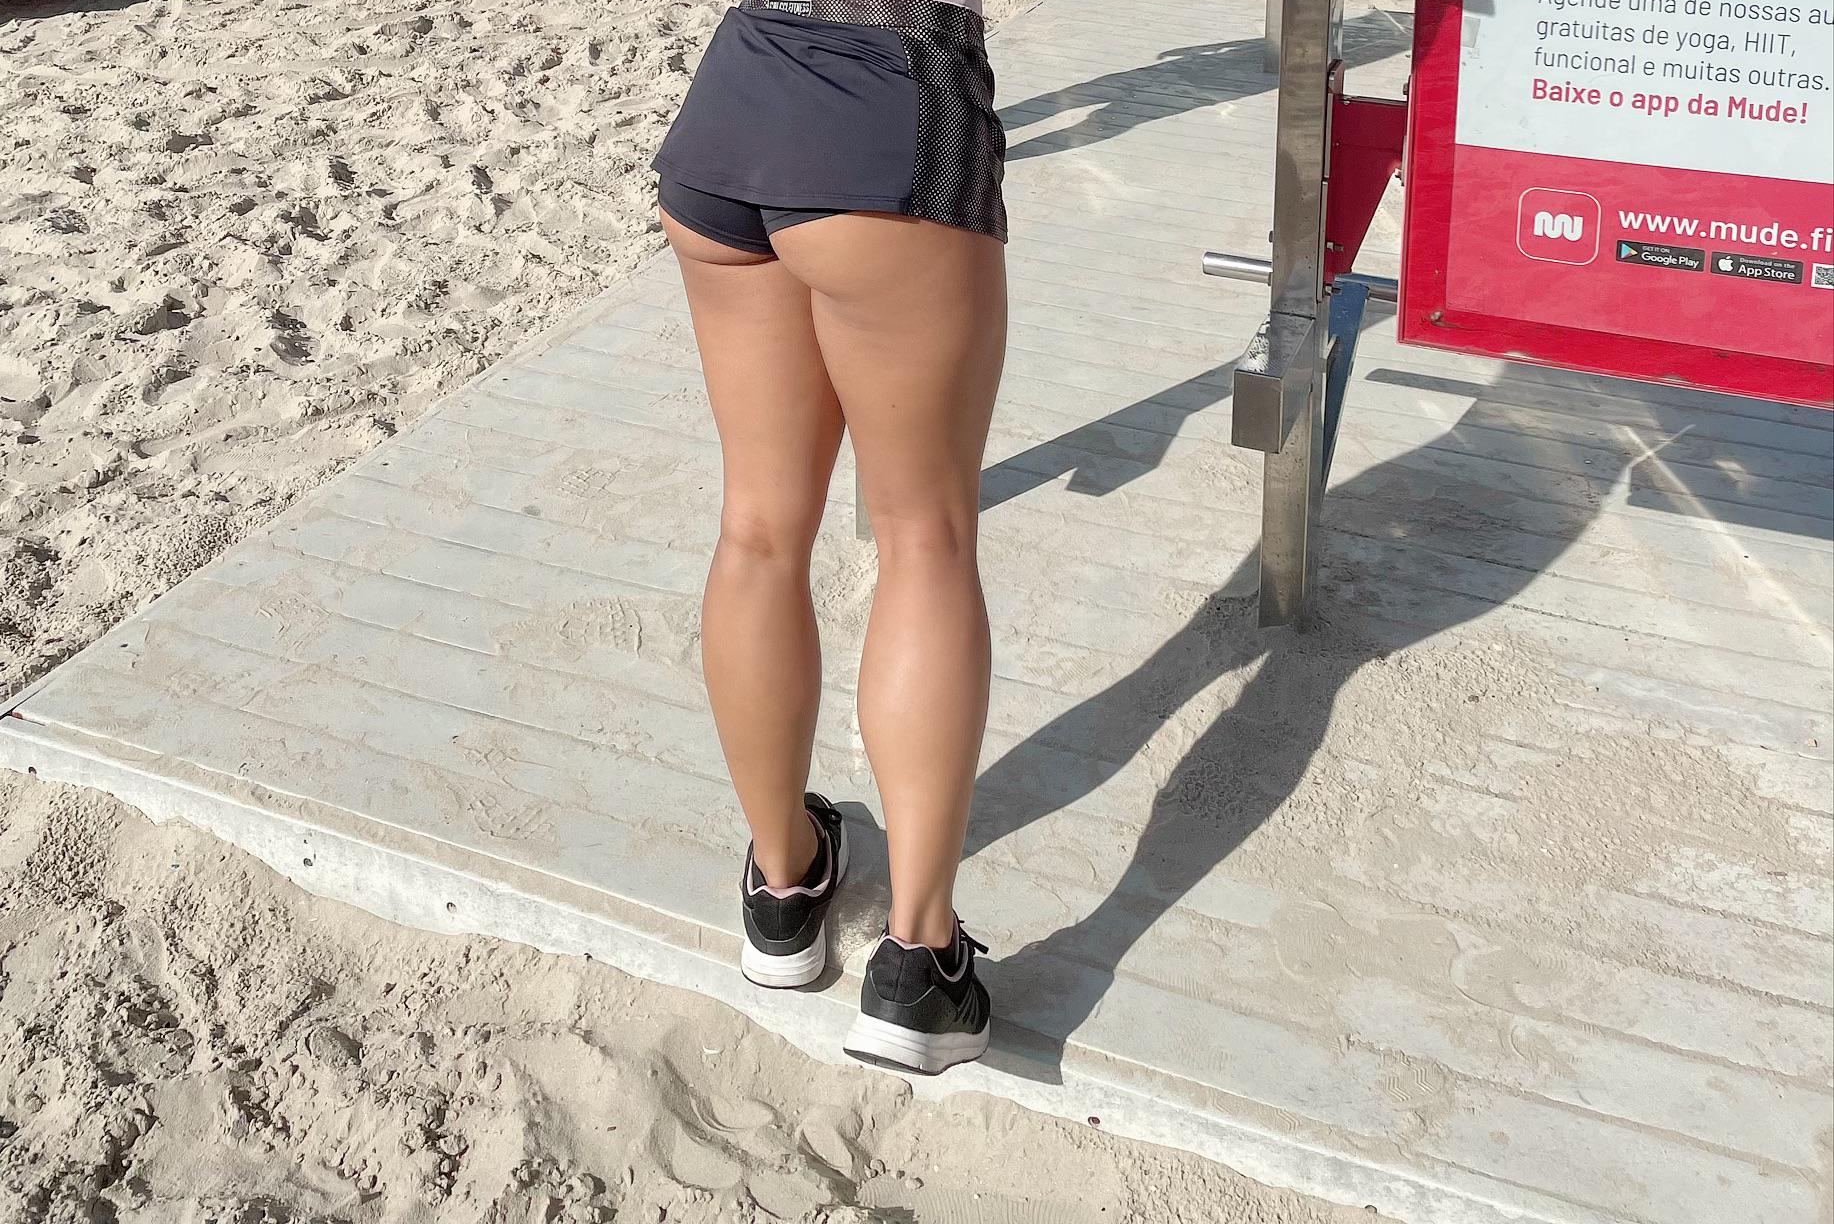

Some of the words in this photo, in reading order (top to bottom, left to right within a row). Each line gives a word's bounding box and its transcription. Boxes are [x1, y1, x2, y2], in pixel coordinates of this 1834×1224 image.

[1719, 1, 1801, 24] nossas
[1535, 19, 1636, 43] gratuitas
[1642, 24, 1669, 46] de
[1675, 31, 1736, 54] yoga,
[1744, 31, 1796, 58] HIIT,
[1534, 46, 1636, 75] funcional
[1642, 60, 1655, 76] e
[1662, 60, 1741, 83] muitas
[1747, 68, 1831, 92] outras.
[1531, 78, 1601, 105] Baixe
[1608, 91, 1624, 107] o
[1631, 93, 1680, 118] app
[1687, 93, 1719, 117] da
[1727, 96, 1808, 125] Mude!
[1641, 251, 1678, 266] Google
[1678, 256, 1700, 269] Play
[1739, 257, 1773, 267] Download
[1738, 264, 1763, 278] App
[1763, 267, 1796, 280] Store
